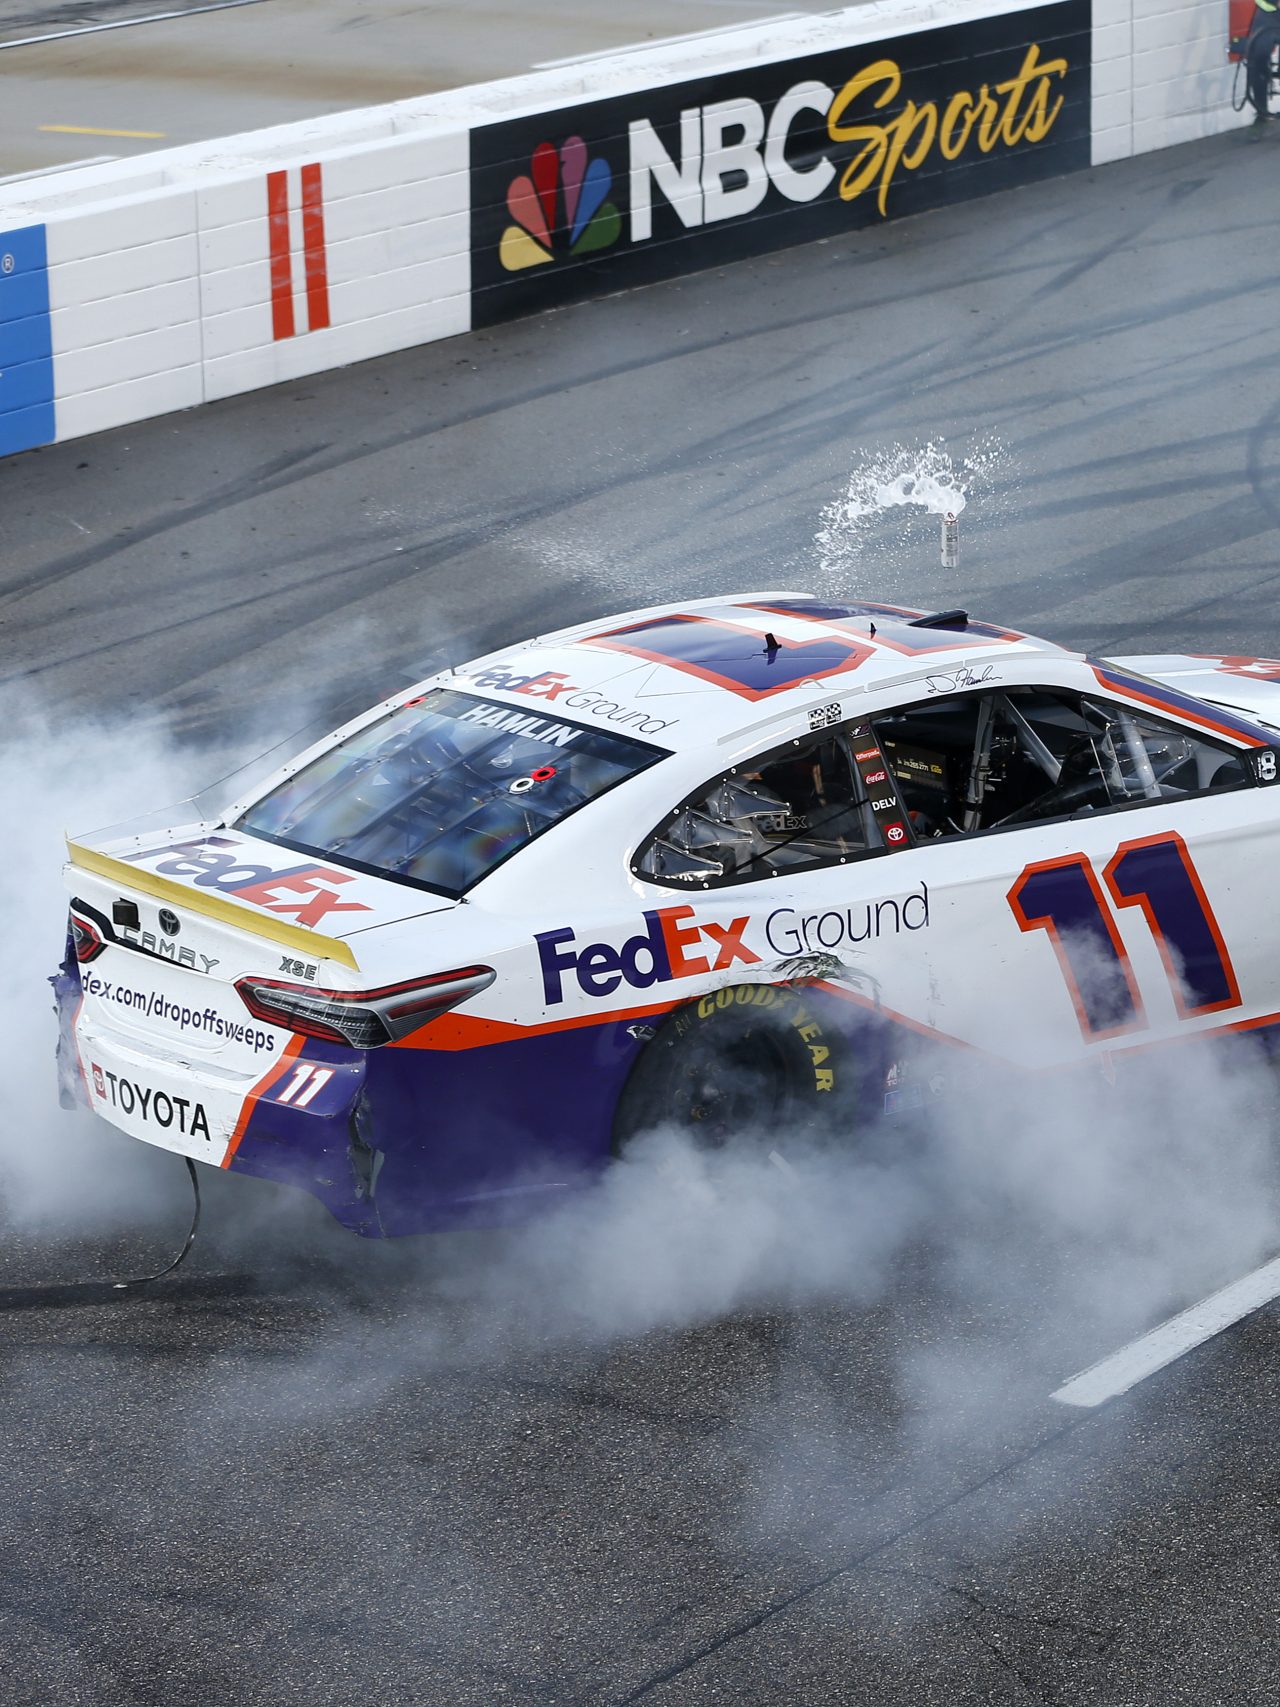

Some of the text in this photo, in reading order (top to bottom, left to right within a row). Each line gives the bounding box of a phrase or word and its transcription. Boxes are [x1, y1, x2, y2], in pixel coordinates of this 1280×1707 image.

[629, 43, 1068, 242] NBC Sports
[458, 703, 585, 747] HAMLIN
[473, 664, 681, 735] FedEx Ground
[116, 836, 375, 929] FedEx
[123, 926, 220, 974] CAMRY
[278, 956, 317, 982] XSE
[533, 881, 930, 1006] FedEx Ground
[1006, 830, 1243, 1045] 11
[105, 1072, 211, 1142] TOYOTA
[277, 1063, 336, 1107] 11
